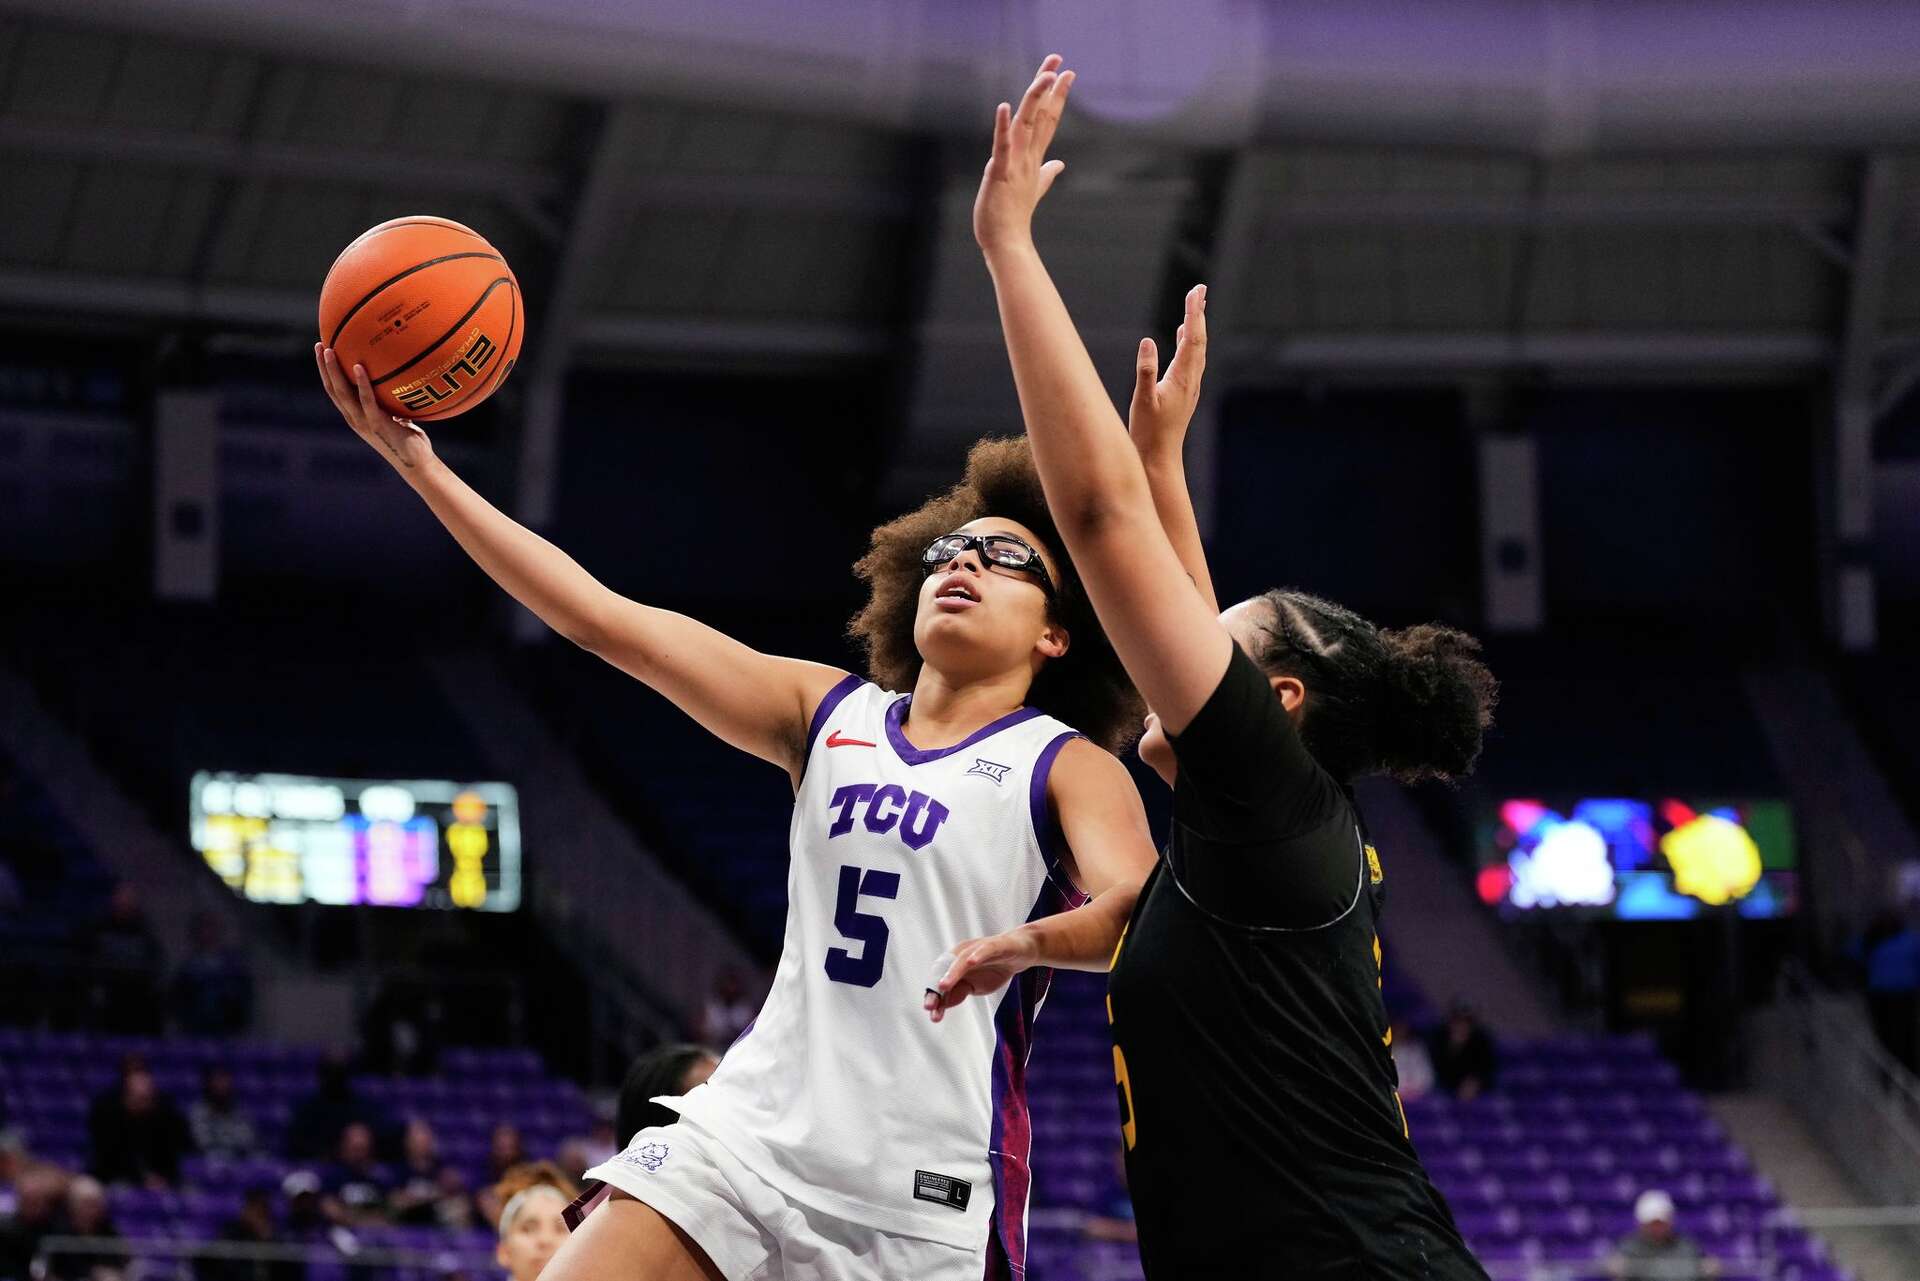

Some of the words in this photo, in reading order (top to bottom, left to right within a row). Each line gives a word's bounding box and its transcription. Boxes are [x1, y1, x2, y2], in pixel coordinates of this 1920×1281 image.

[397, 333, 497, 411] ELITE
[829, 784, 950, 850] TCU
[824, 865, 901, 989] 5
[956, 1187, 962, 1200] L
